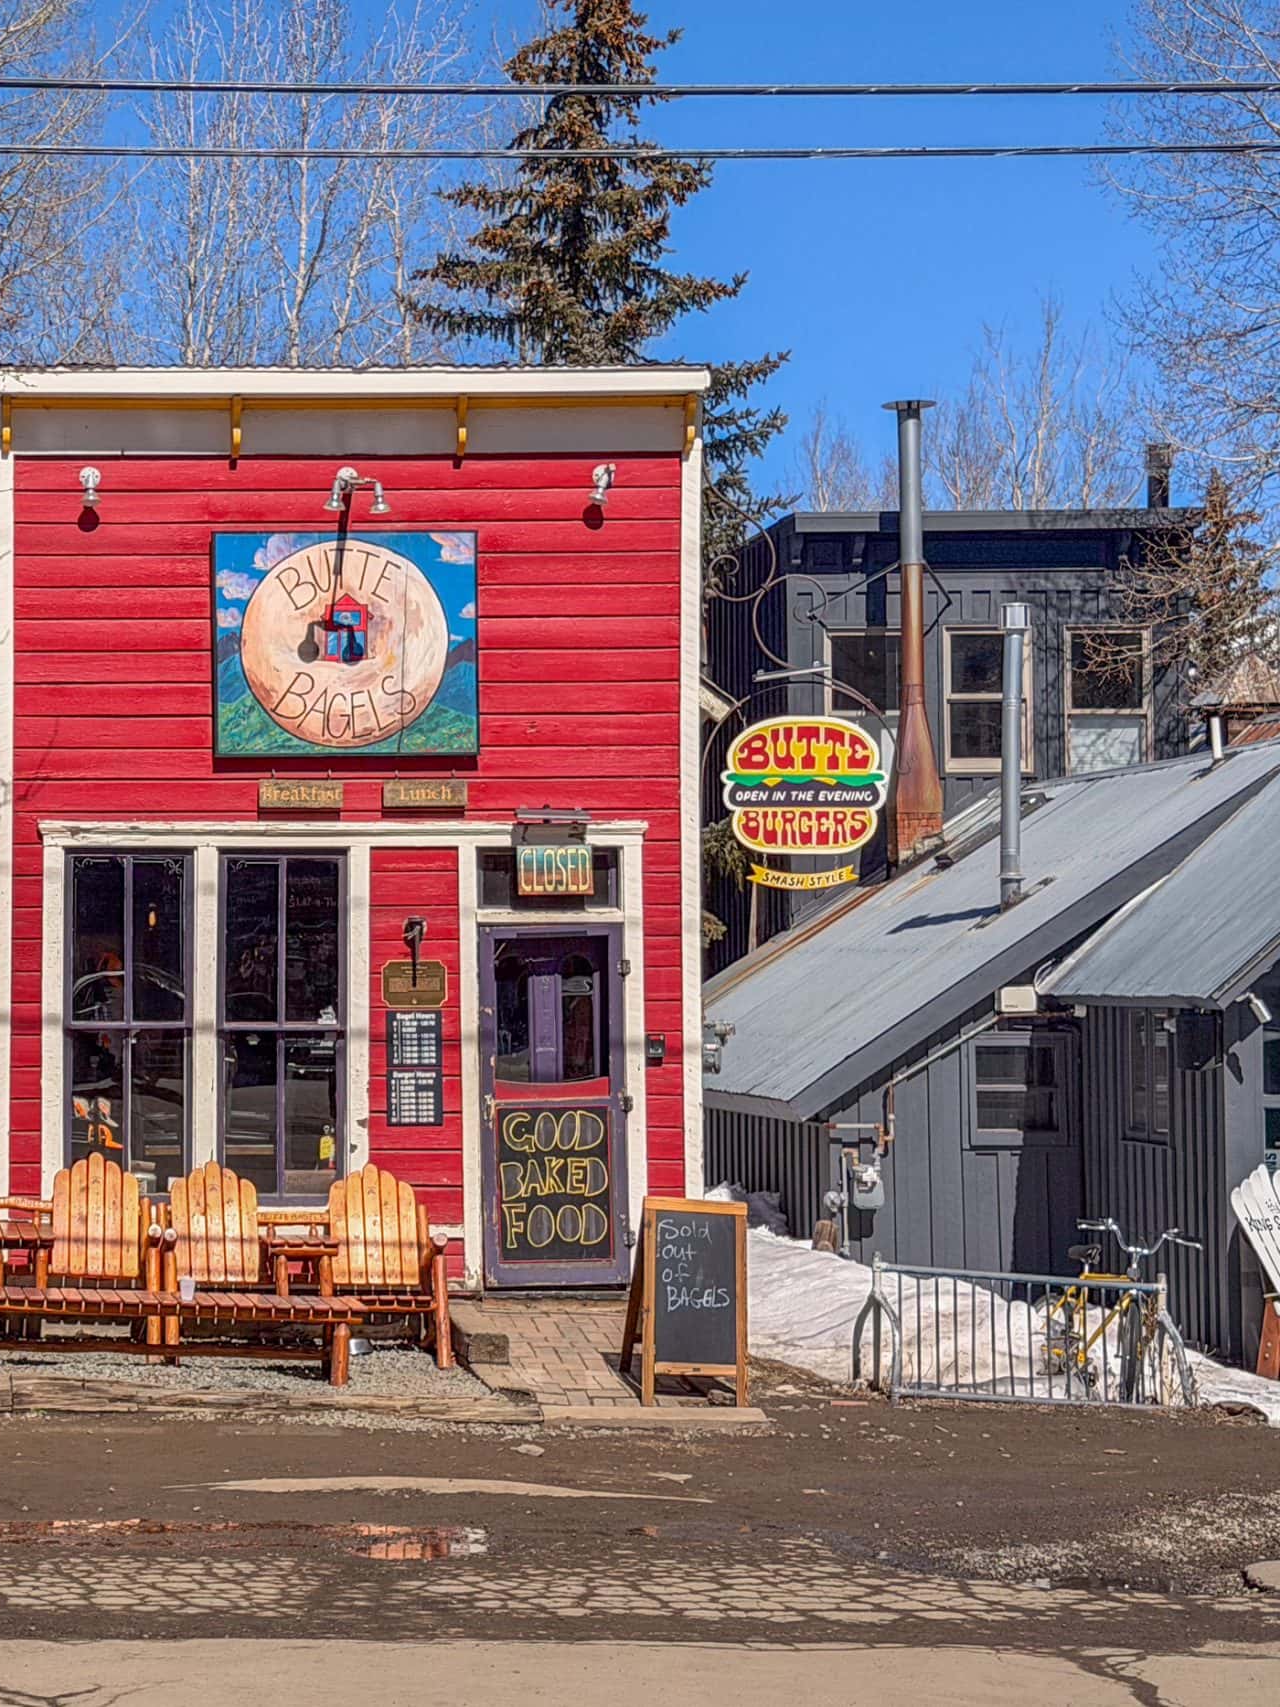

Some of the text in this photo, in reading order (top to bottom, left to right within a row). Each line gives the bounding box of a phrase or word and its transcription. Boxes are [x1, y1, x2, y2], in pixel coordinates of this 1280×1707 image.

[275, 548, 401, 611] BUTTE
[271, 671, 417, 740] BAGELS
[736, 726, 871, 771] BUTTE
[261, 783, 452, 801] Breakfast Lunch
[735, 790, 873, 802] OPEN IN THE EVENING
[741, 810, 870, 846] BURGERS
[520, 847, 589, 892] CLOSED
[762, 871, 847, 887] SMASH STYLE
[503, 1110, 604, 1153] GOOD
[500, 1156, 609, 1201] BAKED
[502, 1202, 608, 1249] FOOD
[660, 1218, 712, 1242] Sold
[667, 1284, 730, 1312] BAGELS
